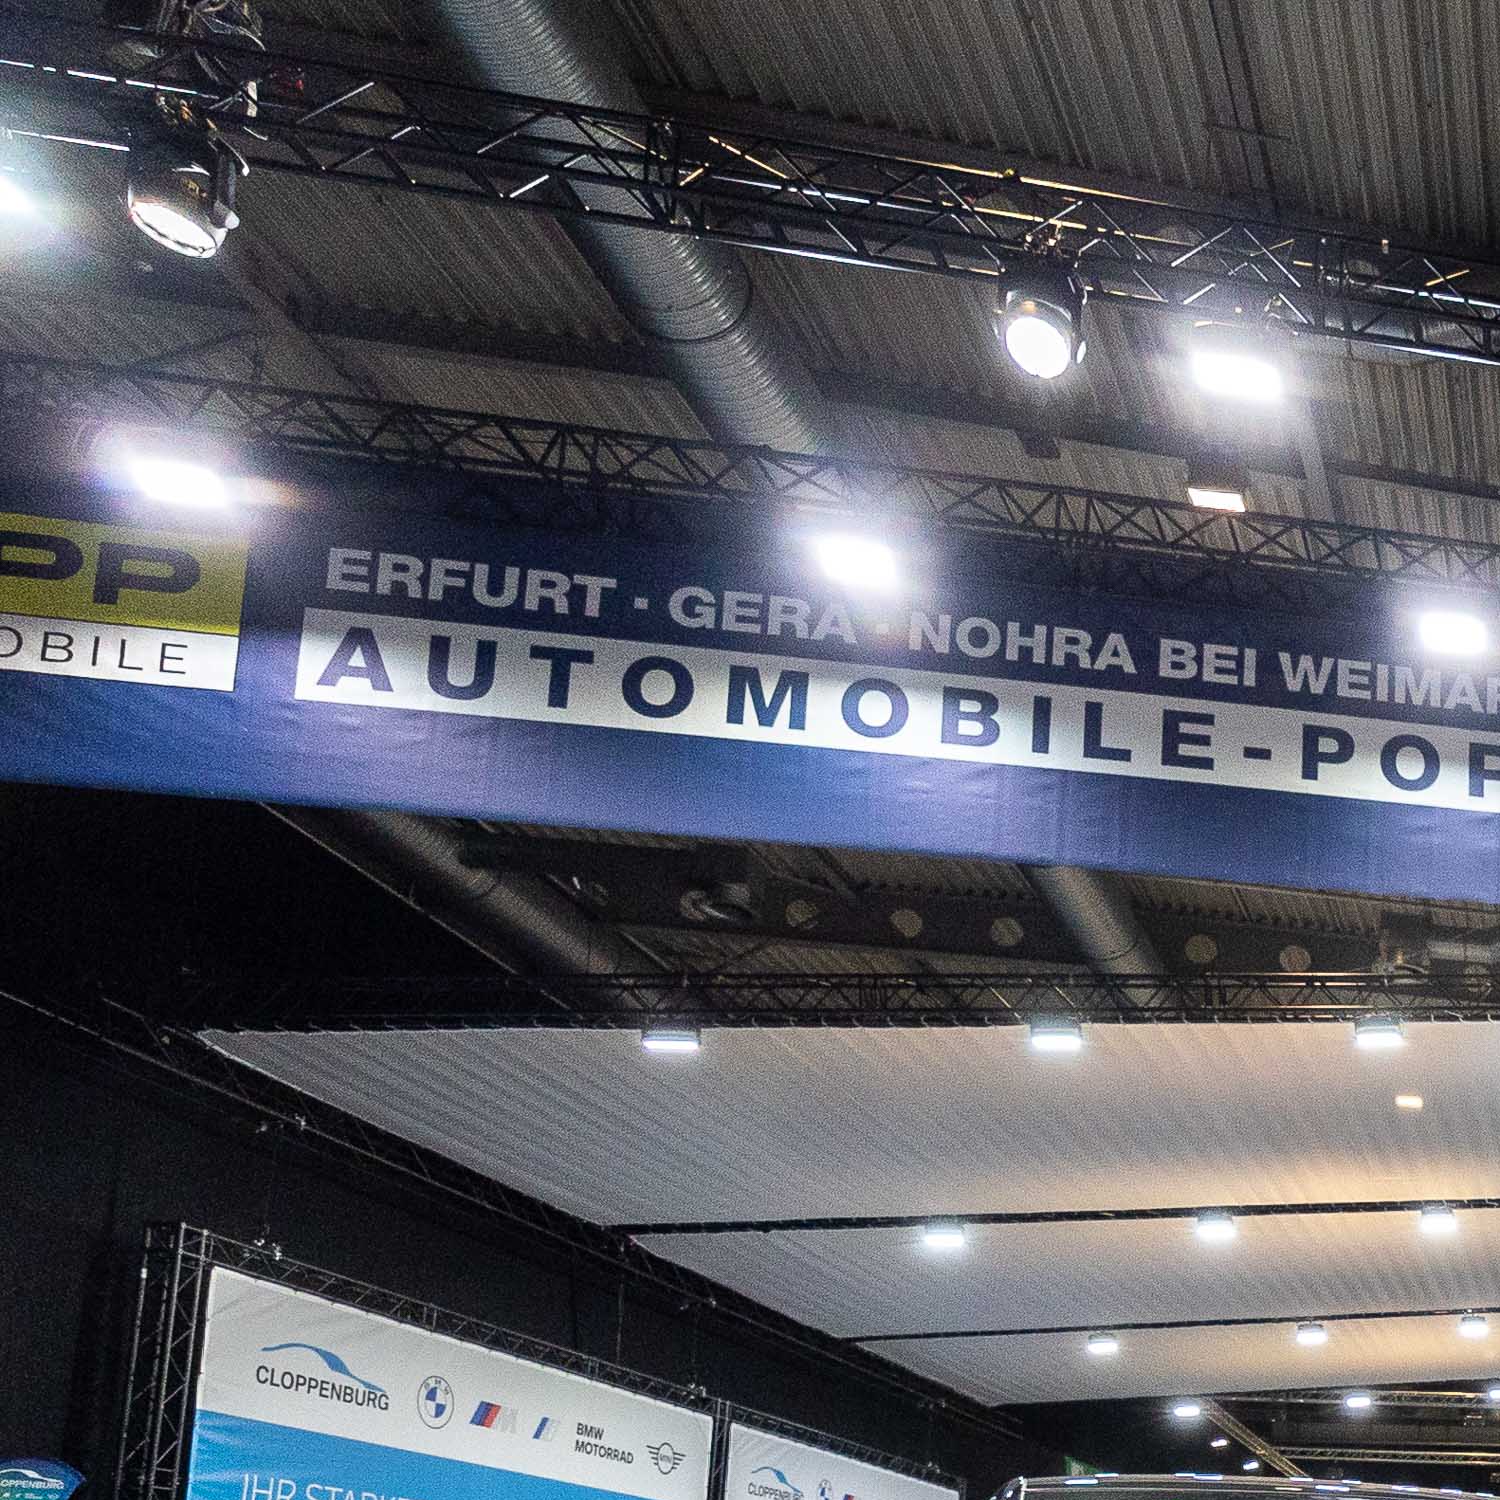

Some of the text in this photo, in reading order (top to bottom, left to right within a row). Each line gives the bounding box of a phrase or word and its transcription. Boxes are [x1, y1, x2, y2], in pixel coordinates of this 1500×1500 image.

[325, 547, 617, 618] ERFURT
[668, 586, 857, 643] GERA
[907, 612, 1138, 674] NOHRA
[1159, 638, 1258, 688] BEI
[256, 1365, 390, 1411] CLOPPENBURG
[576, 1422, 605, 1441] BMW
[575, 1440, 635, 1464] MOTORRAD
